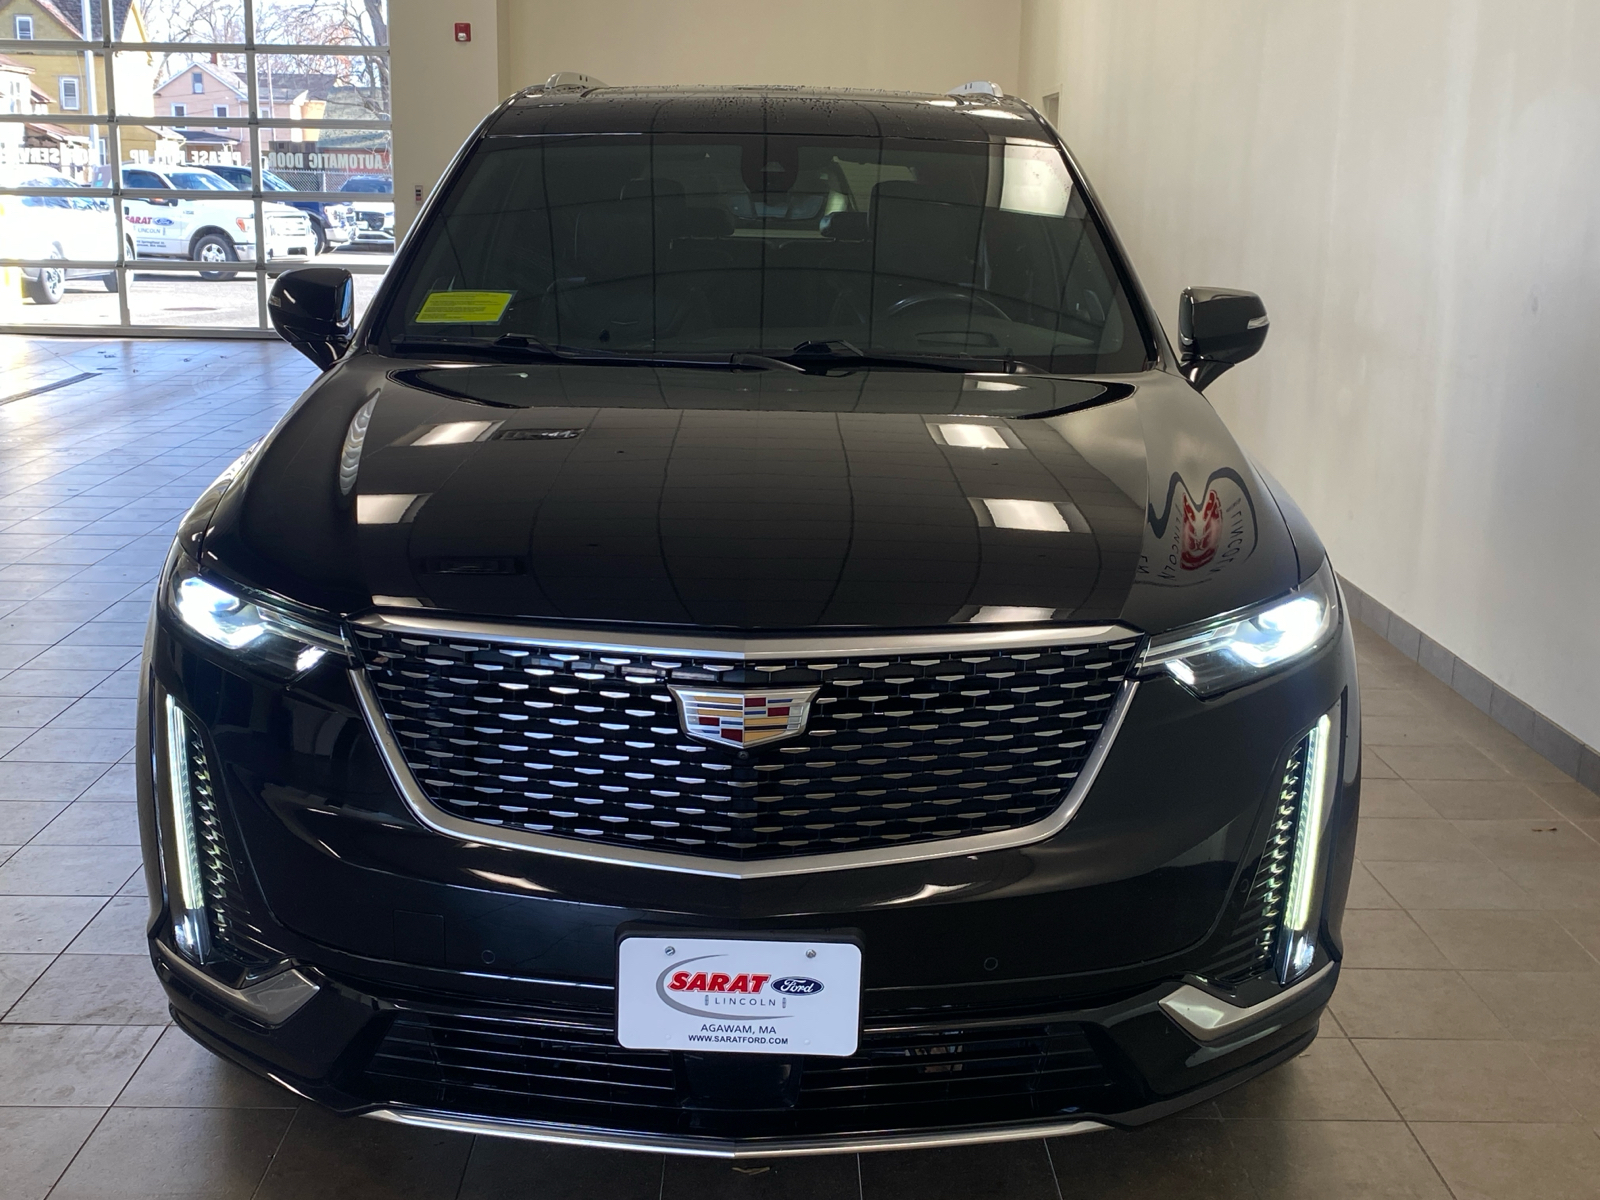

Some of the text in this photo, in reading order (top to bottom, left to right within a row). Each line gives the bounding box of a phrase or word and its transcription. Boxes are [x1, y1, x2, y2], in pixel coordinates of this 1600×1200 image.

[667, 971, 814, 994] SARAT Ford
[714, 997, 776, 1007] LINCOLN
[700, 1023, 777, 1035] AGAWAM, MA
[688, 1034, 789, 1045] WWW.SARATFORD.COM
